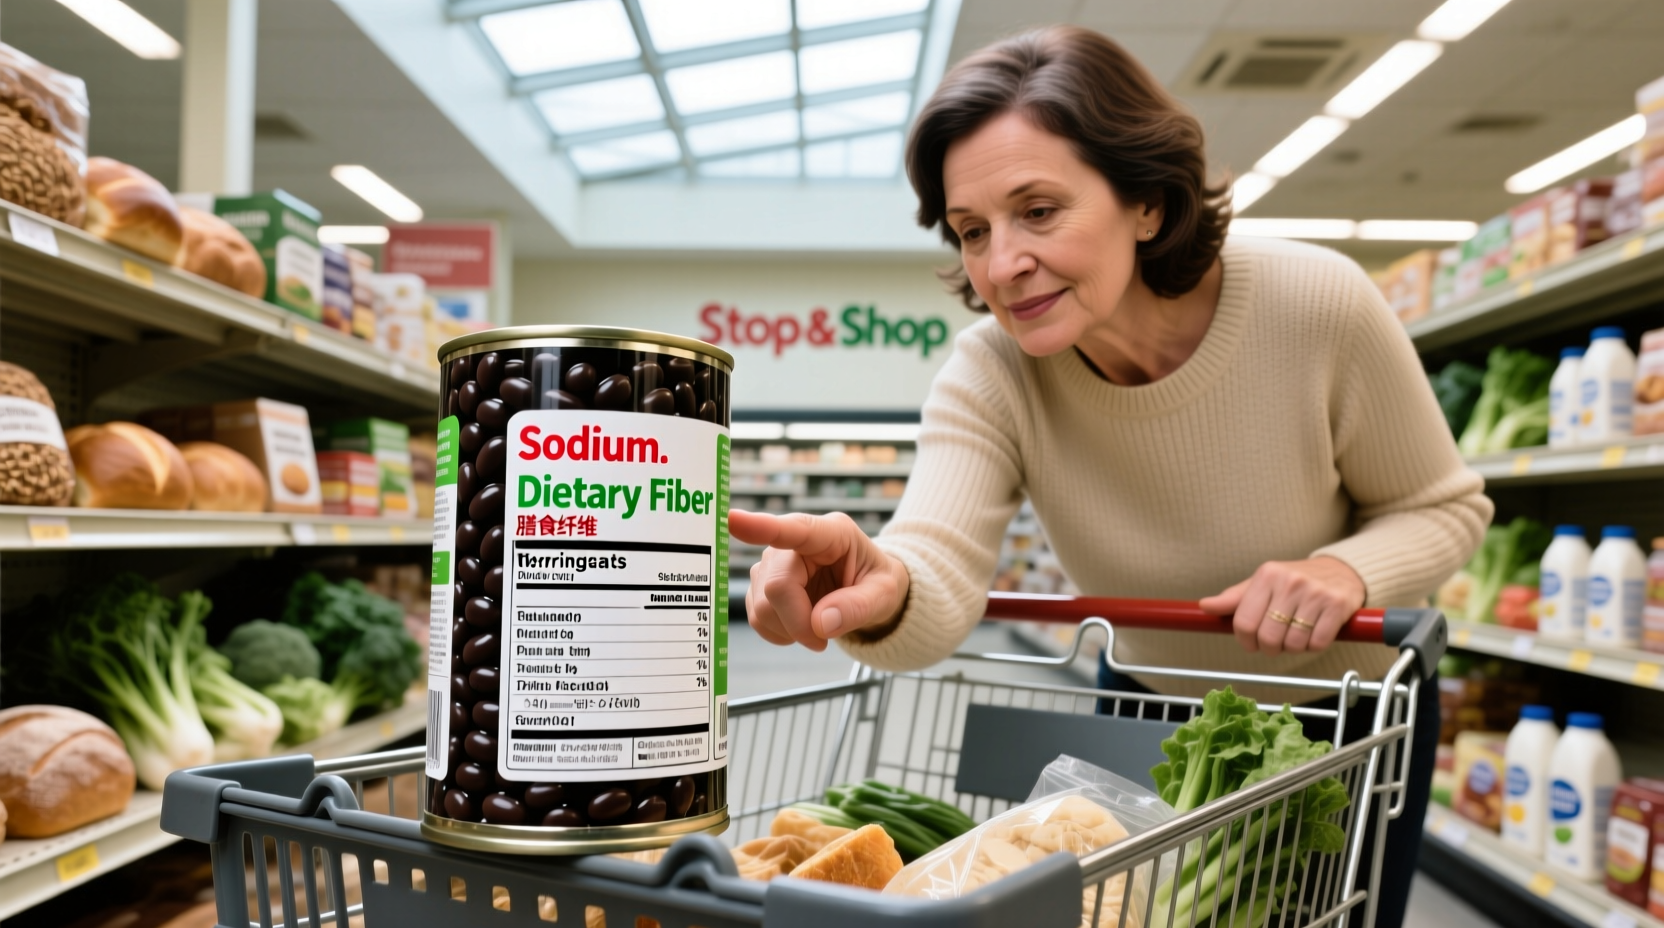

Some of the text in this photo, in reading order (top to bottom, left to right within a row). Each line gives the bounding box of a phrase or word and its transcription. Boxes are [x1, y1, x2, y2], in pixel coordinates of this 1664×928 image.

[518, 425, 669, 464] Sodium.
[518, 474, 713, 519] Dietary Fiber
[516, 514, 598, 537] 膳食纤维
